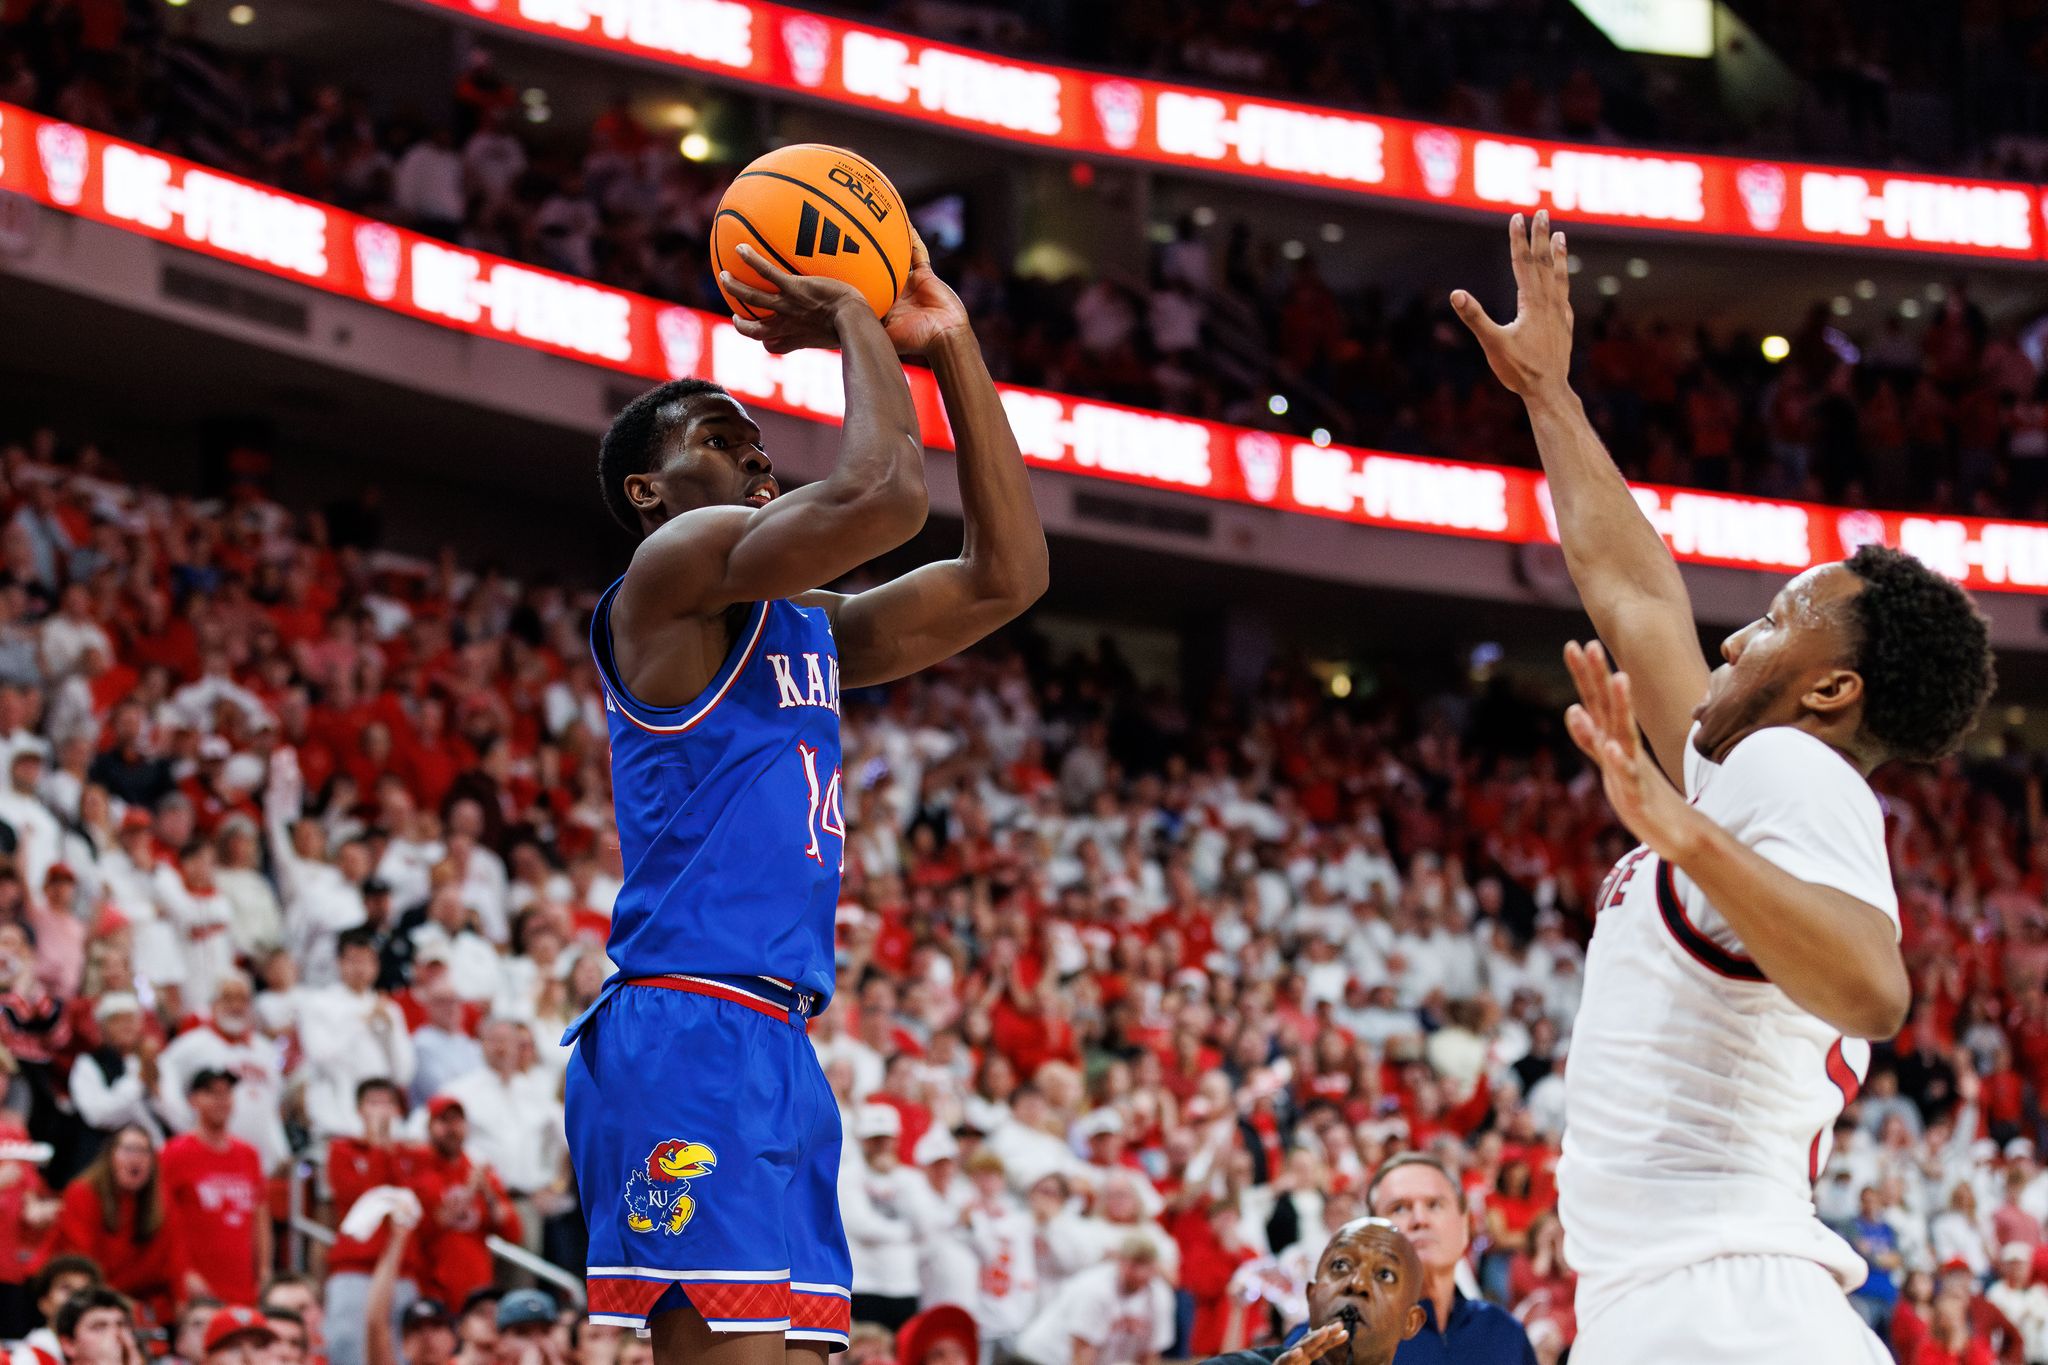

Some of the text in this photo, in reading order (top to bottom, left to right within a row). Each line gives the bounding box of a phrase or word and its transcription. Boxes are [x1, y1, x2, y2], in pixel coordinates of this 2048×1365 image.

[828, 168, 888, 223] PRO
[797, 740, 846, 877] 14
[648, 1189, 668, 1208] KU
